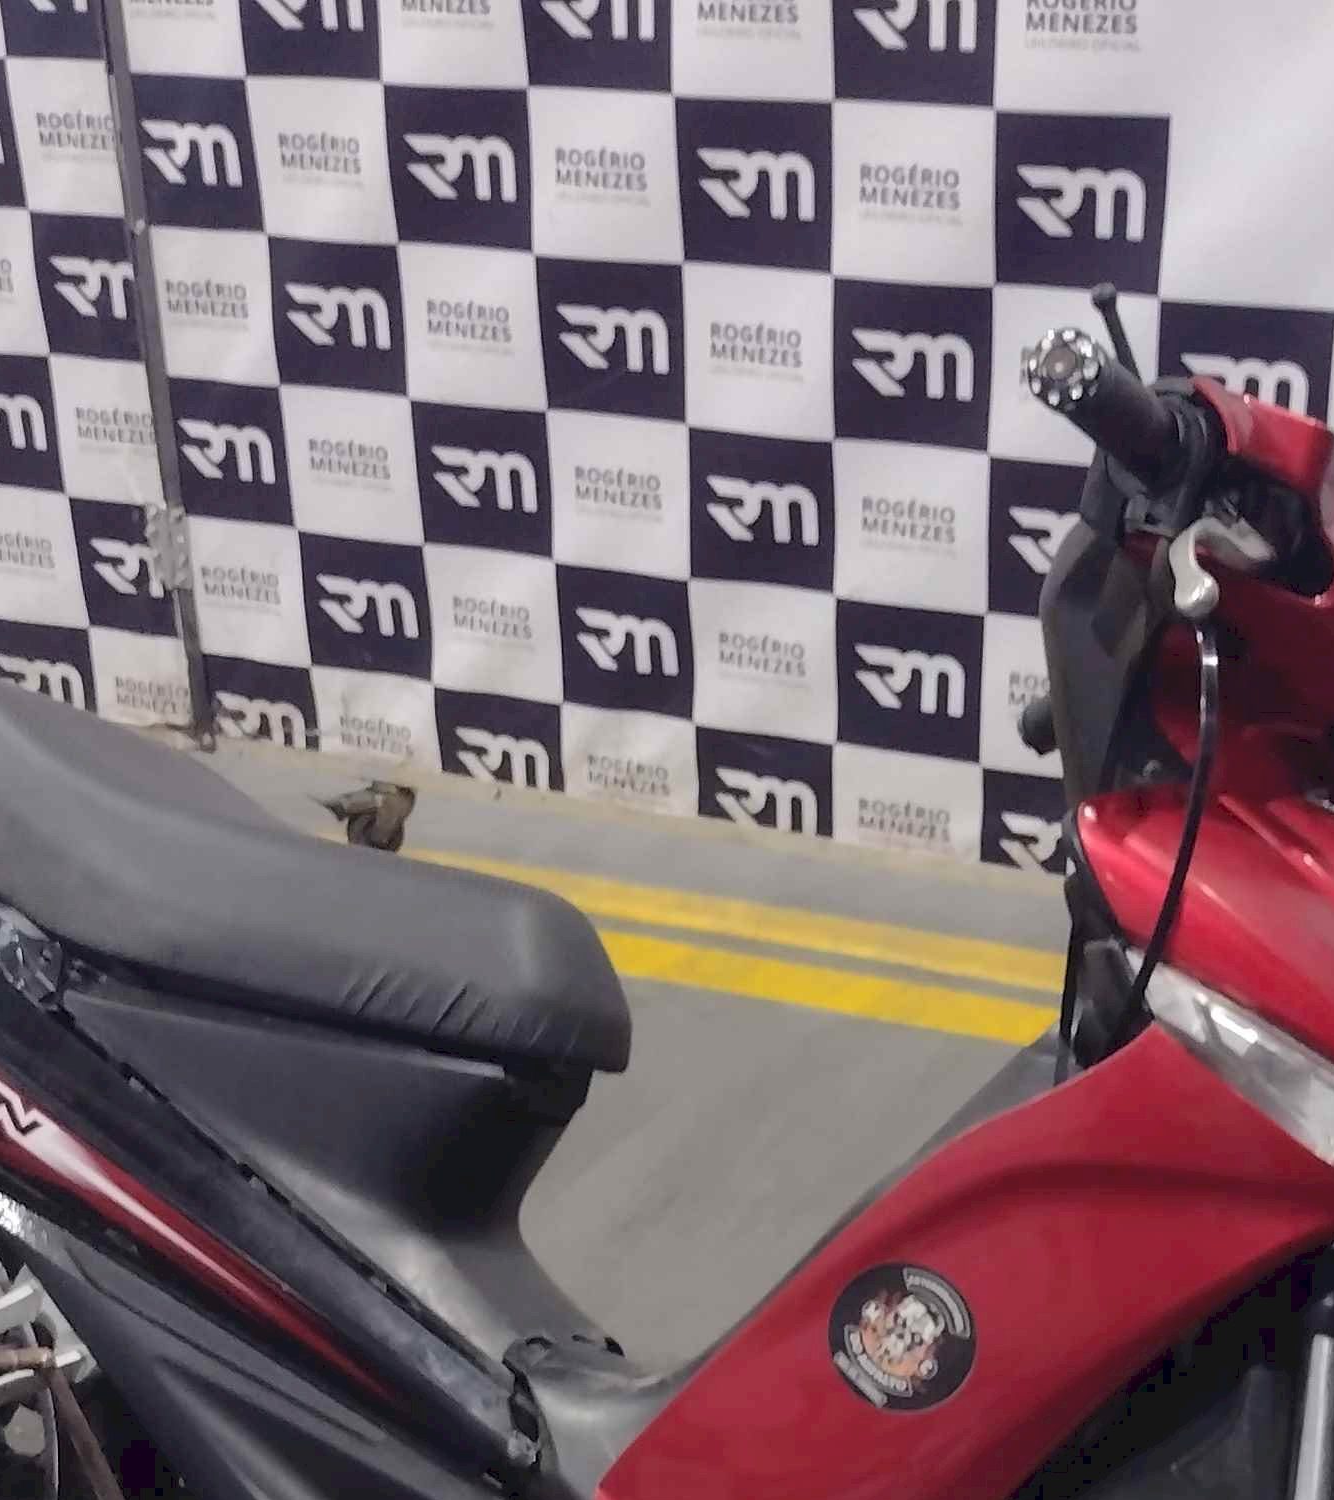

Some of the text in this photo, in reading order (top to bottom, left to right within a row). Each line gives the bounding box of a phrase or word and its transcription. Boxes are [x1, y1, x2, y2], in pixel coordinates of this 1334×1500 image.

[697, 0, 798, 23] MENEZES
[1026, 12, 1137, 34] MENEZES
[277, 131, 363, 156] ROGÉRIO
[279, 152, 366, 173] MENEZES
[553, 147, 646, 172] ROGÉRIO
[554, 167, 648, 191] MENEZES
[858, 163, 960, 190] ROGÉRIO
[858, 185, 961, 210] MENEZES
[166, 279, 247, 302] ROGÉRIO
[168, 298, 249, 320] MENEZES
[424, 300, 511, 325] ROGÉRIO
[425, 318, 513, 342] MENEZES
[709, 322, 803, 349] ROGÉRIO
[709, 341, 804, 367] MENEZES
[307, 438, 390, 464] ROGÉRIO
[309, 455, 393, 480] MENEZES
[573, 465, 661, 493] ROGÉRIO
[574, 483, 663, 510] MENEZES
[860, 498, 957, 525] ROGÉRIO
[860, 516, 958, 543] MENEZES
[201, 565, 279, 587] ROGÉRIO
[205, 583, 281, 605] MENEZES
[448, 596, 531, 624] ROGÉRIO
[449, 613, 533, 639] MENEZES
[716, 632, 807, 660] ROGÉRIO
[717, 649, 808, 676] MENEZES
